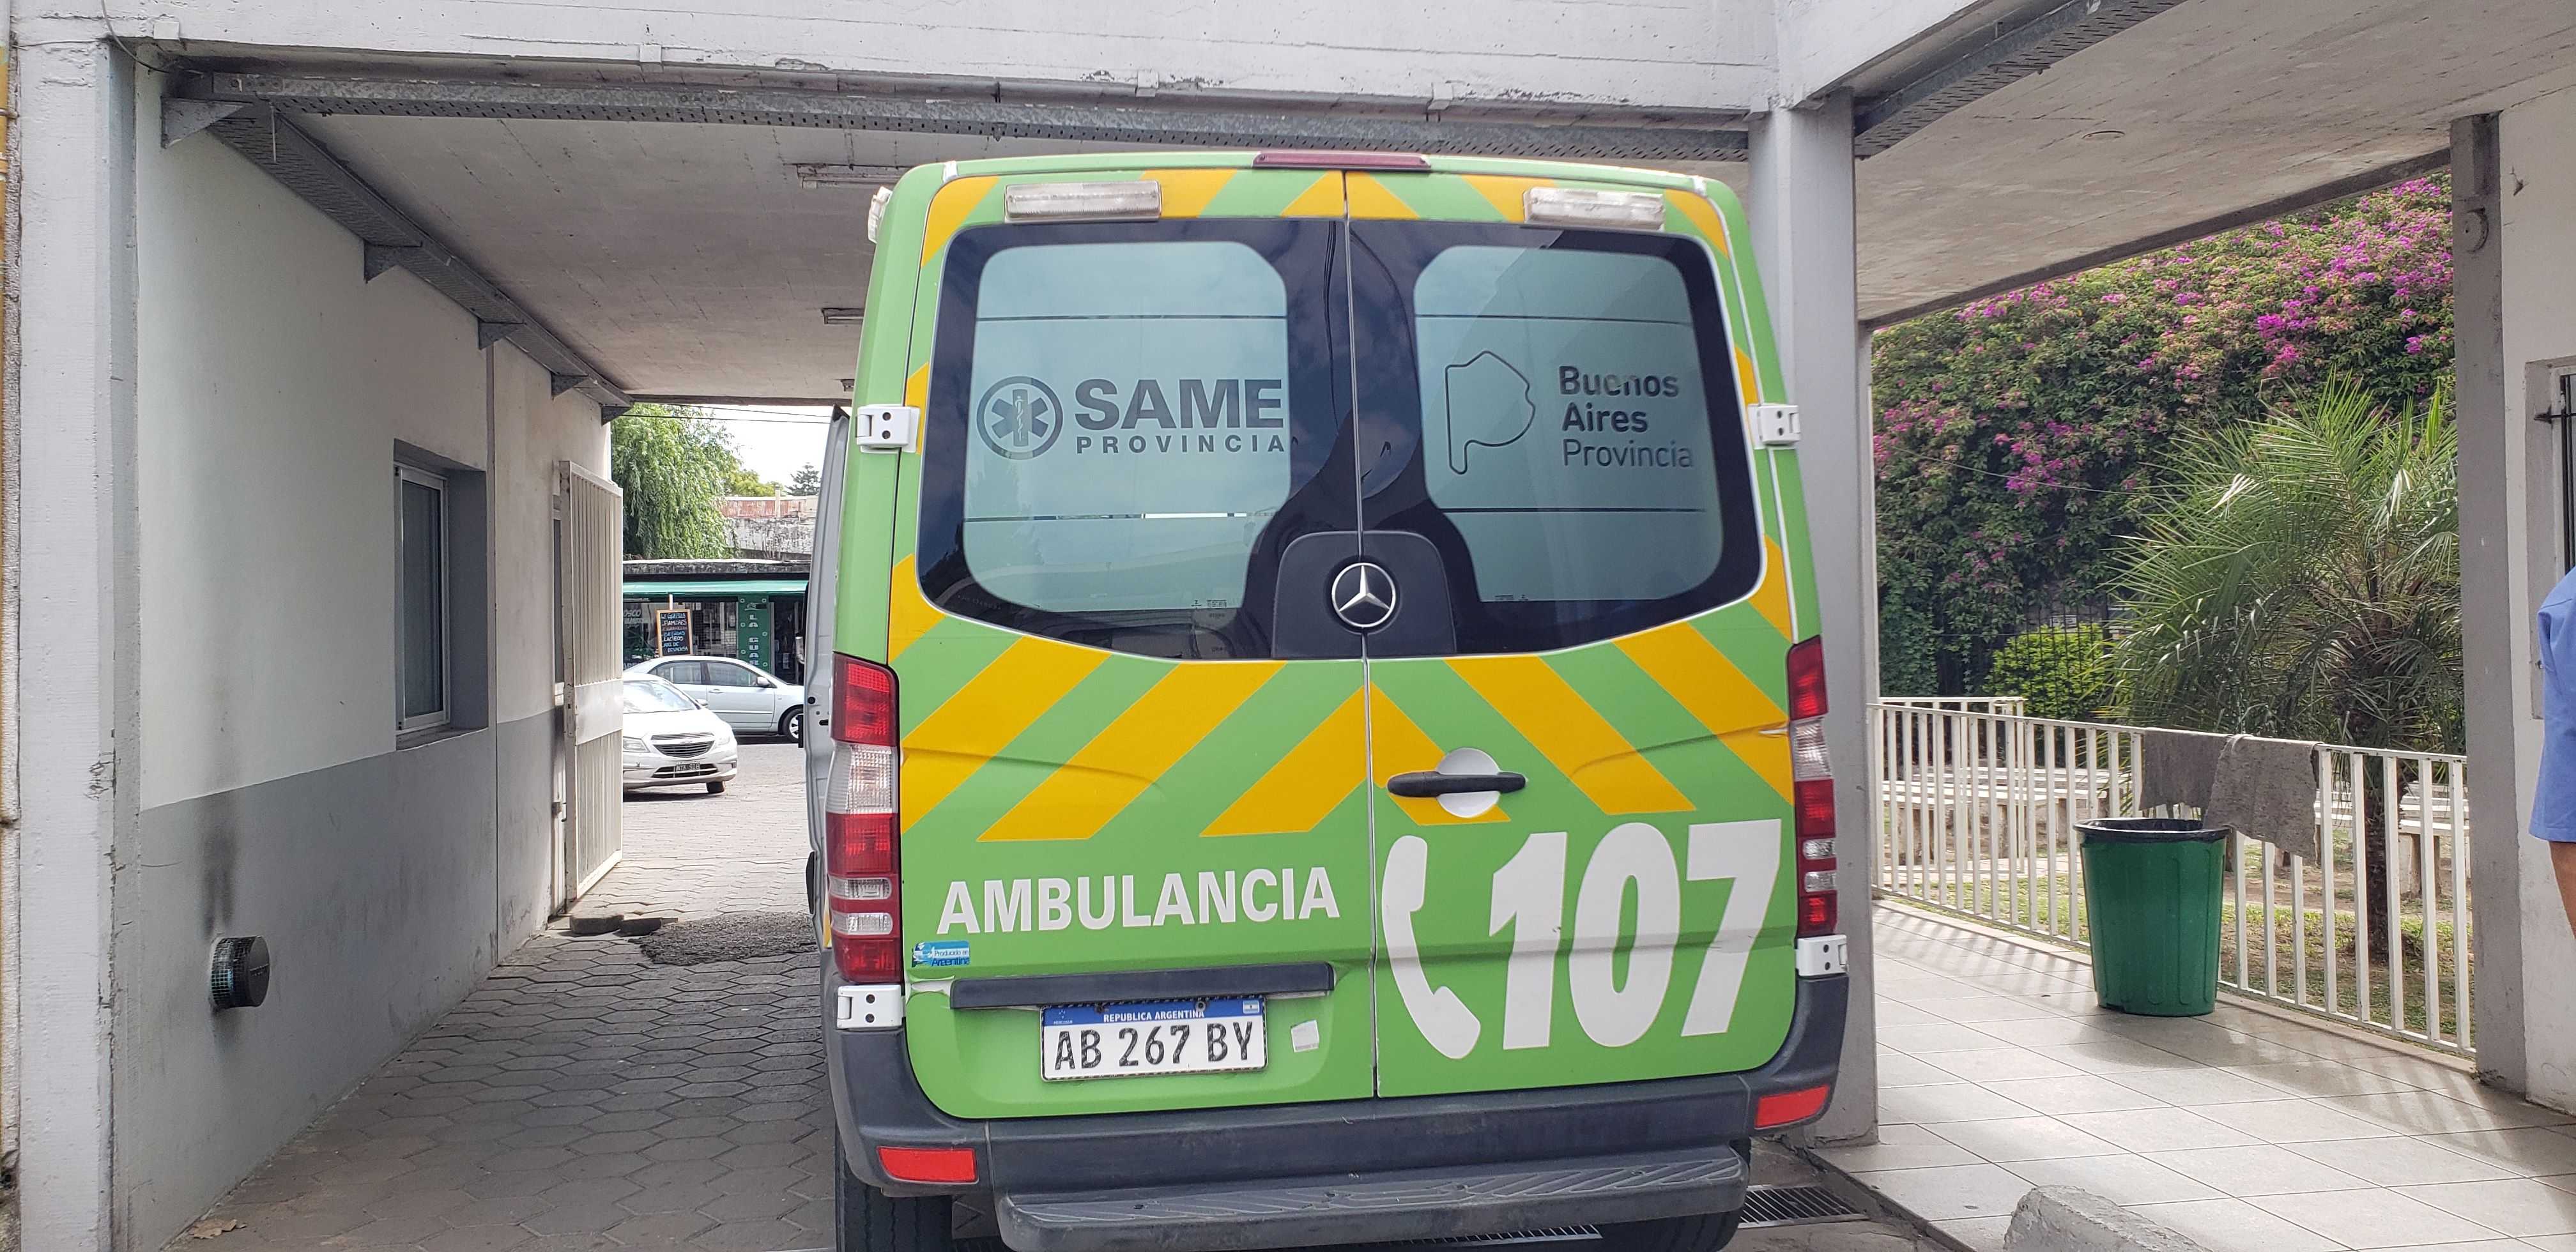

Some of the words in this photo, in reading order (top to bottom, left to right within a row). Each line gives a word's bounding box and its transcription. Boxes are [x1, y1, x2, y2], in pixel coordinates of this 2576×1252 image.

[1558, 365, 1680, 397] Buenos
[1075, 378, 1284, 431] SAME
[1561, 402, 1648, 433] Aires
[1076, 434, 1285, 454] PROVINCIA
[1563, 439, 1694, 468] Provincia
[749, 615, 758, 627] LA
[936, 867, 1341, 935] AMBULANCIA
[1489, 818, 1782, 1050] 107
[1103, 1011, 1152, 1023] REPUBLICA
[1155, 1010, 1205, 1020] ARGENTINA
[1055, 1029, 1101, 1070] AB
[1118, 1025, 1190, 1067] 267
[1207, 1021, 1253, 1062] BY
